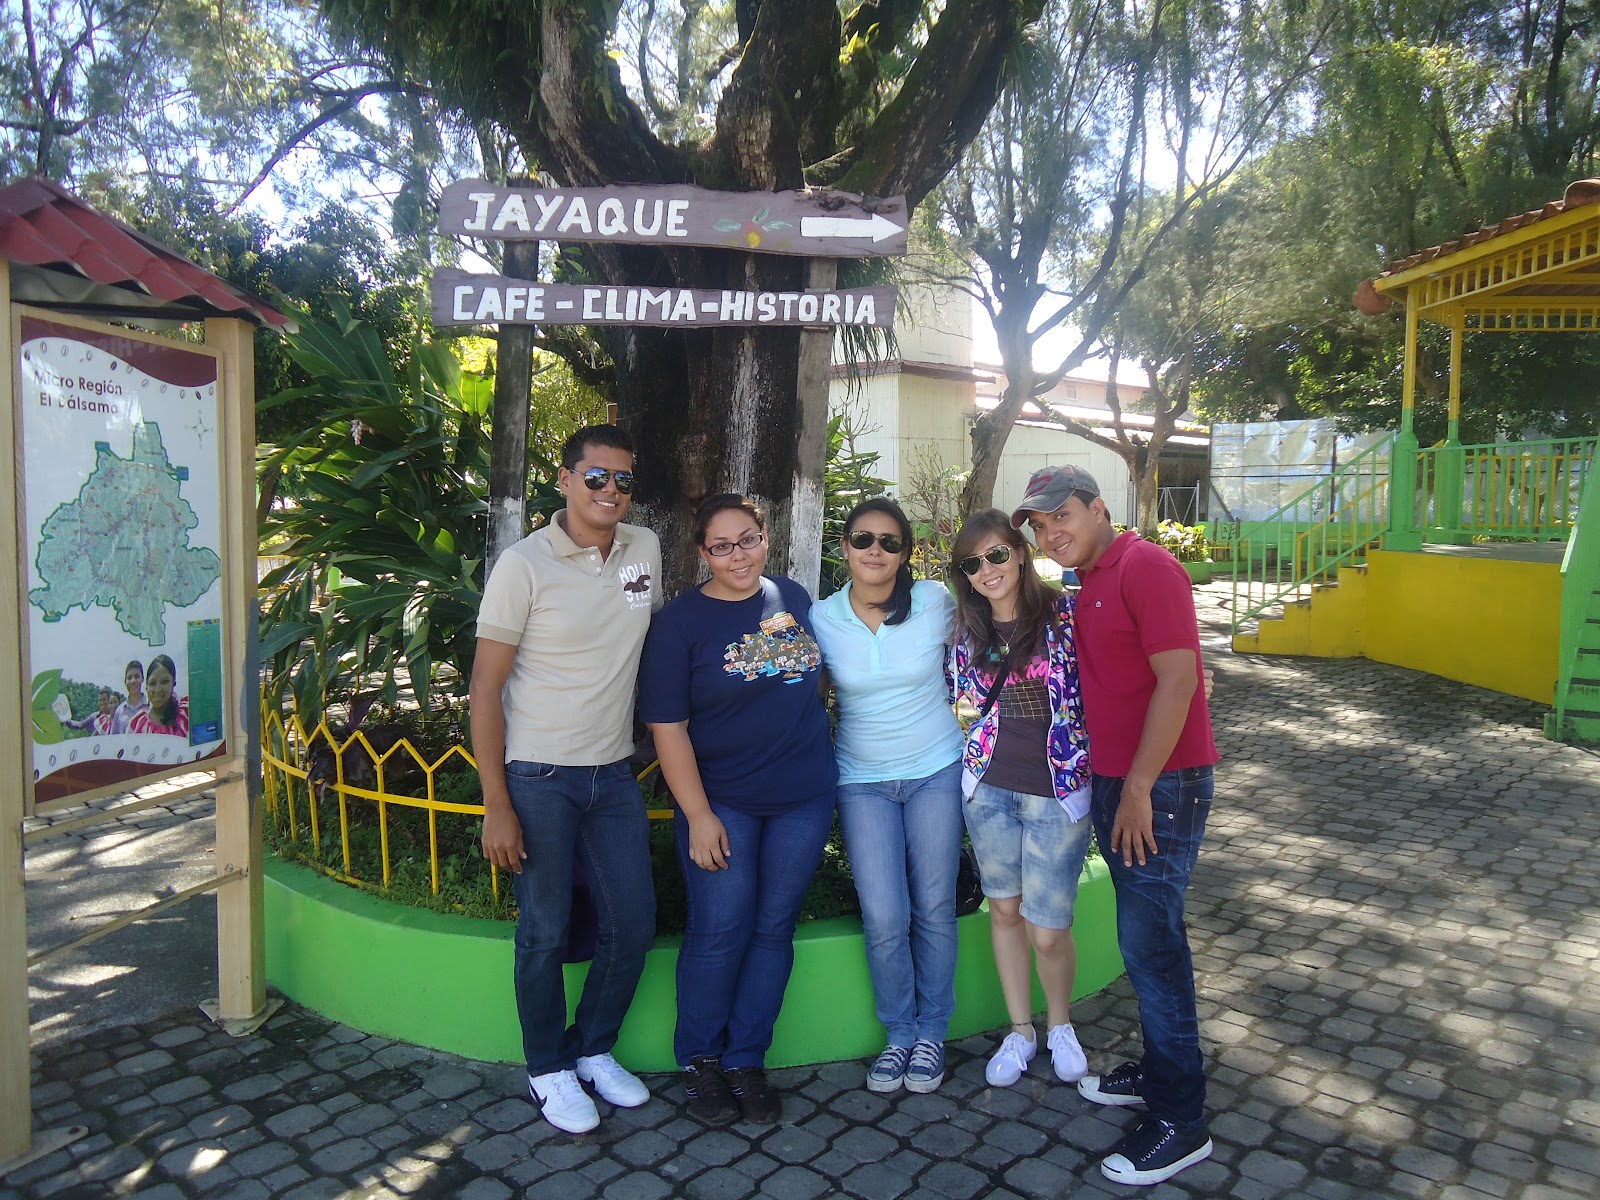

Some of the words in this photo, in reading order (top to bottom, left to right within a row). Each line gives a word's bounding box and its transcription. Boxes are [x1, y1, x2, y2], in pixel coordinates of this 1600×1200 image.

[463, 192, 690, 237] JAYAQUE
[453, 285, 545, 321] CAFE
[34, 370, 74, 388] Micro
[79, 376, 122, 396] Región
[40, 392, 51, 407] El
